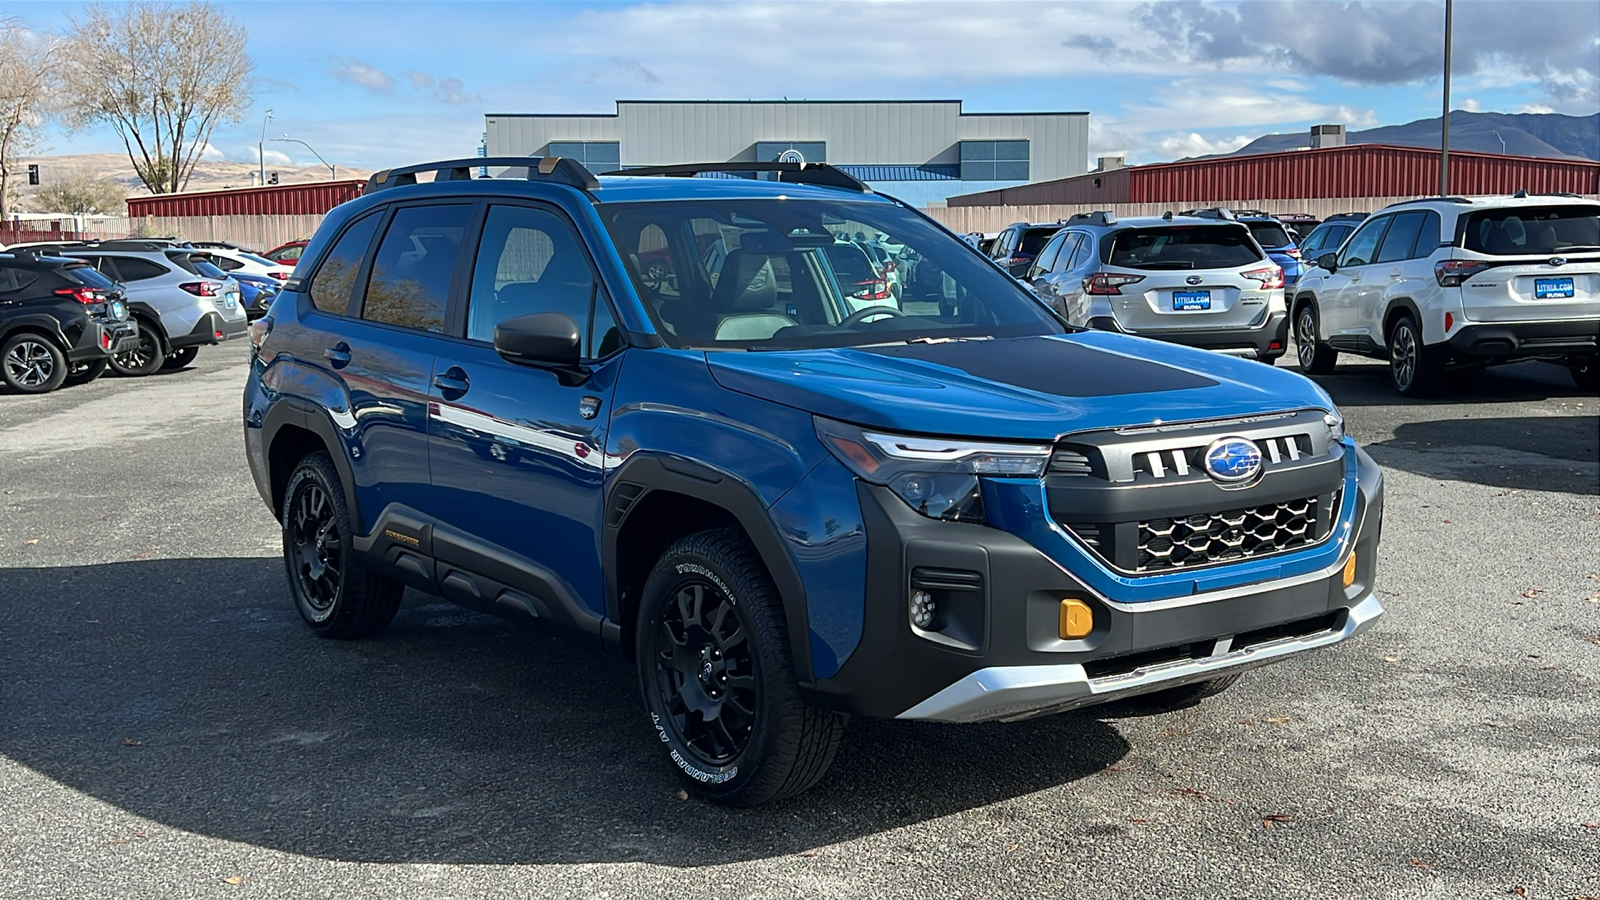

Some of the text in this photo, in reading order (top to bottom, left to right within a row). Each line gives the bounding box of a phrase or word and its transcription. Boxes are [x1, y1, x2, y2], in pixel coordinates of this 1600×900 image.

[1174, 296, 1210, 304] LITHIA.COM
[1536, 284, 1573, 293] LITHIA.COM
[675, 562, 737, 606] YOKOHAMA
[650, 711, 738, 784] GEOLANDAR A/T
